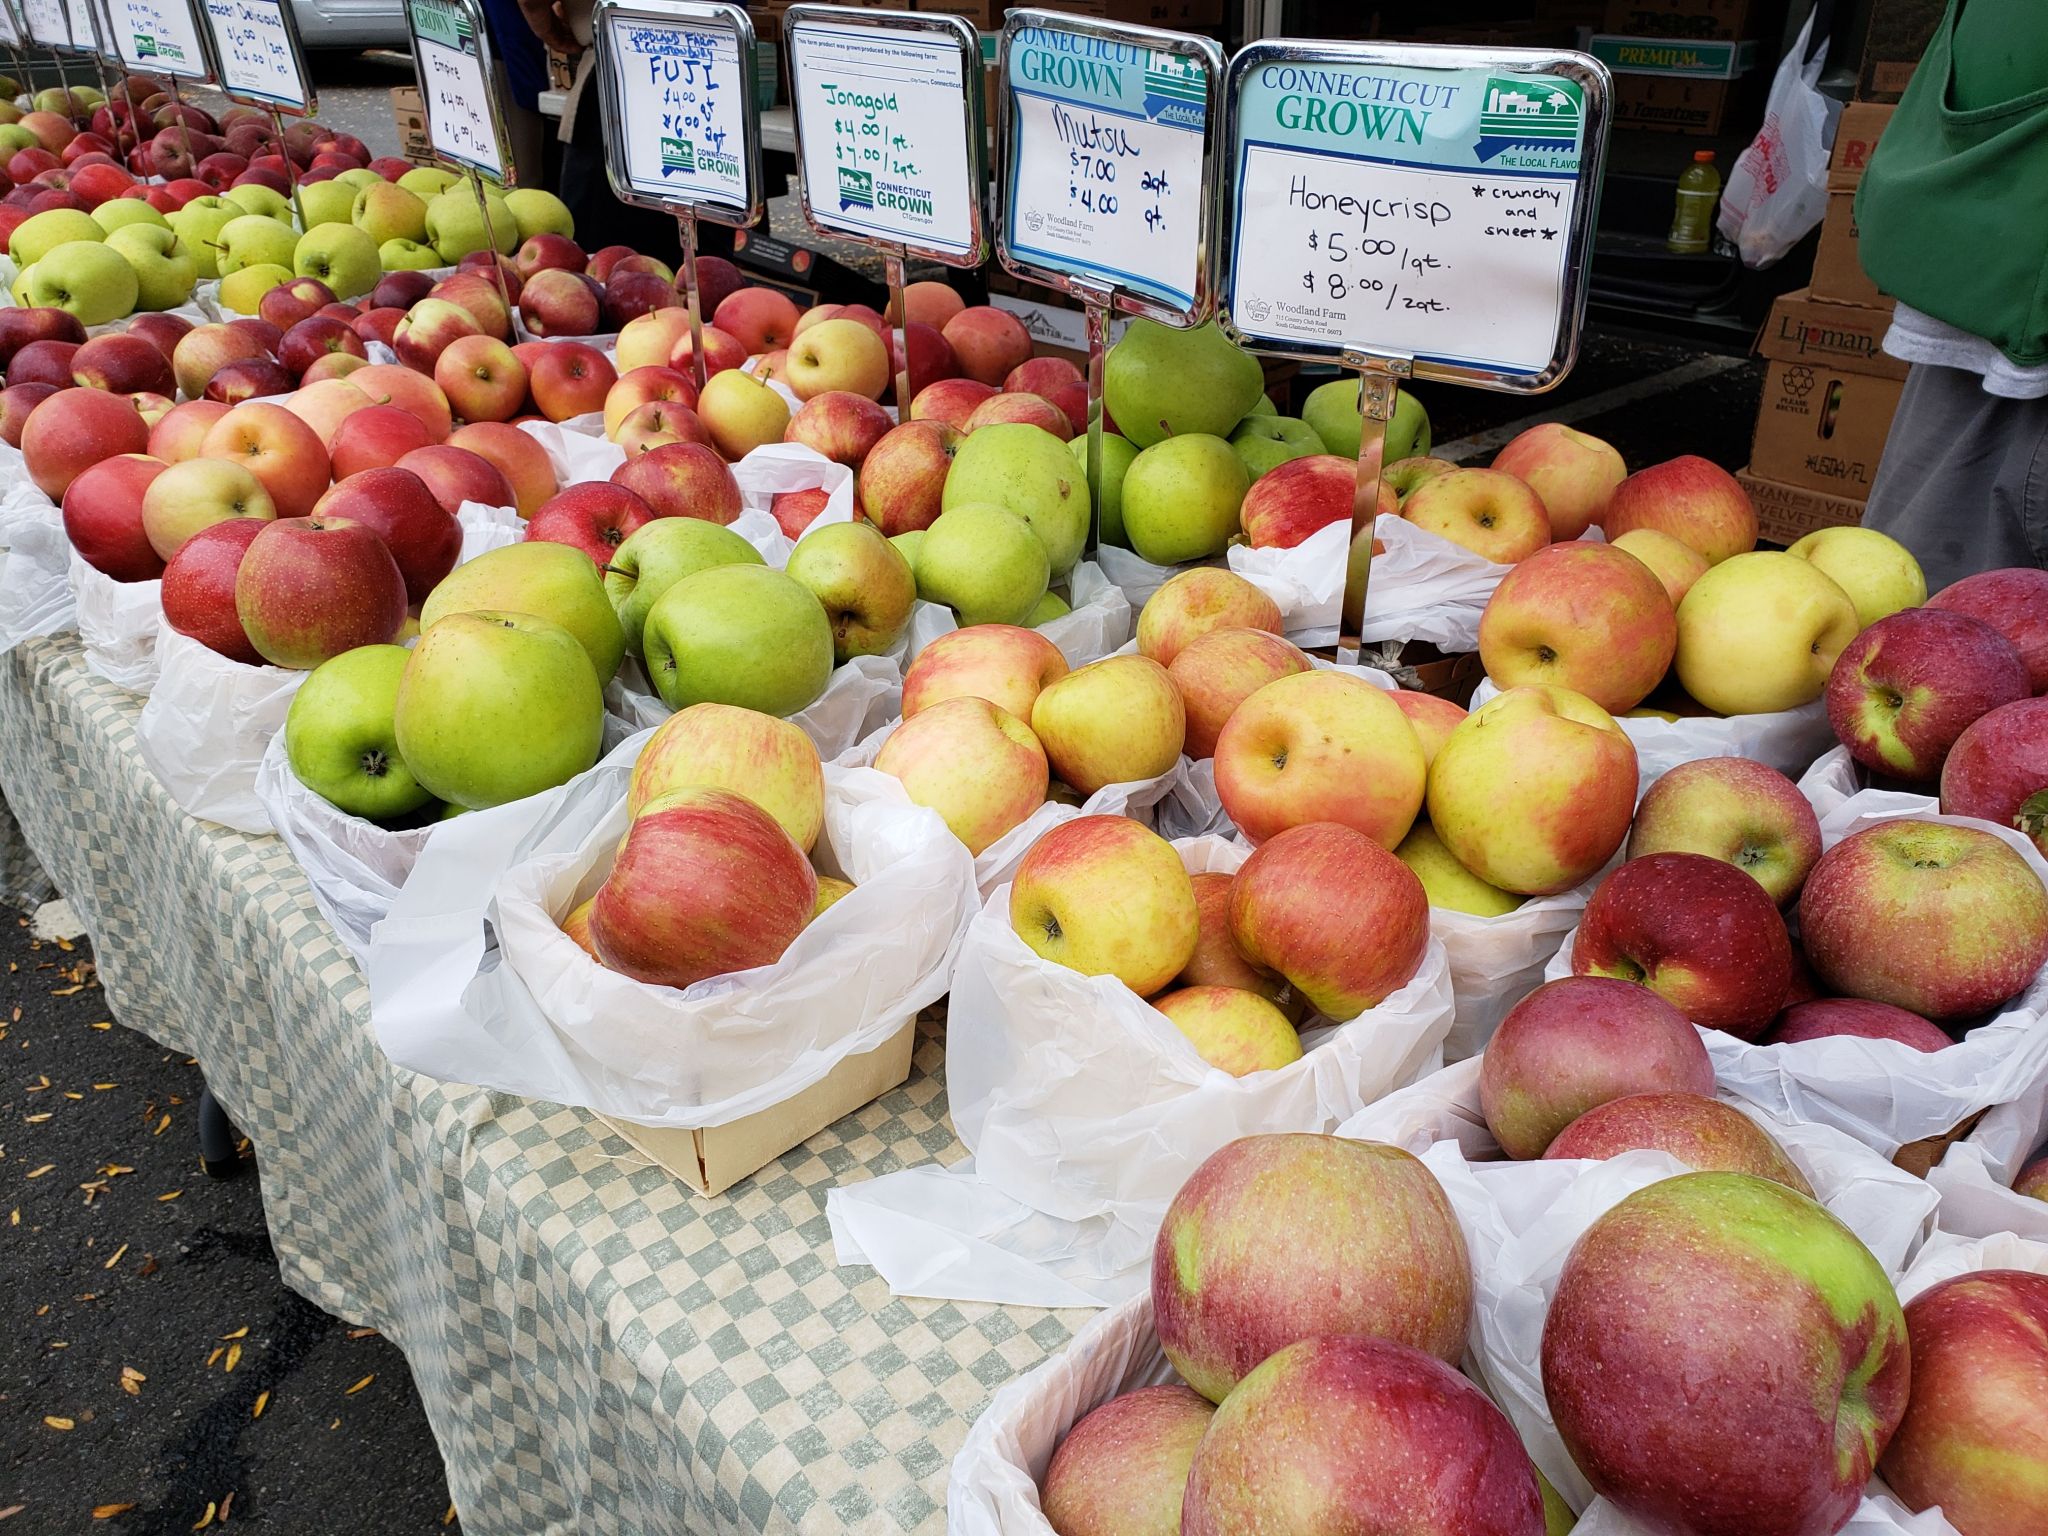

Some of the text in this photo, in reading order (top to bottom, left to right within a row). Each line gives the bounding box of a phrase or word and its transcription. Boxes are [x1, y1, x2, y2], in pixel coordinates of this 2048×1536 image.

[416, 8, 450, 35] GROWN
[158, 47, 185, 59] GROWN
[819, 40, 836, 49] product
[885, 48, 891, 56] by
[900, 50, 924, 60] following
[1618, 47, 1698, 66] PREMIUM
[433, 54, 460, 80] Empire
[650, 55, 719, 90] FUJI
[1021, 49, 1123, 99] GROWN
[1262, 66, 1460, 109] CONNECTICUT
[820, 83, 899, 120] Jonagold
[1276, 95, 1432, 145] GROWN
[1634, 102, 1709, 122] Tomatoes
[1051, 104, 1140, 157] Mutsu
[697, 148, 738, 163] CONNECTICUT
[1500, 154, 1517, 167] THE
[1520, 155, 1547, 168] LOCAL
[698, 157, 740, 178] GROWN
[876, 181, 931, 200] CONNECTICUT
[877, 190, 933, 217] GROWN
[1289, 175, 1451, 233] Honeycrisp
[1047, 213, 1078, 228] Woodland
[1079, 220, 1094, 232] Farm
[1505, 208, 1537, 220] and
[1276, 301, 1320, 317] Woodland
[1322, 308, 1347, 320] Farm
[1284, 315, 1303, 324] Country
[1742, 483, 1789, 503] PMAN
[1760, 504, 1818, 526] VELVET
